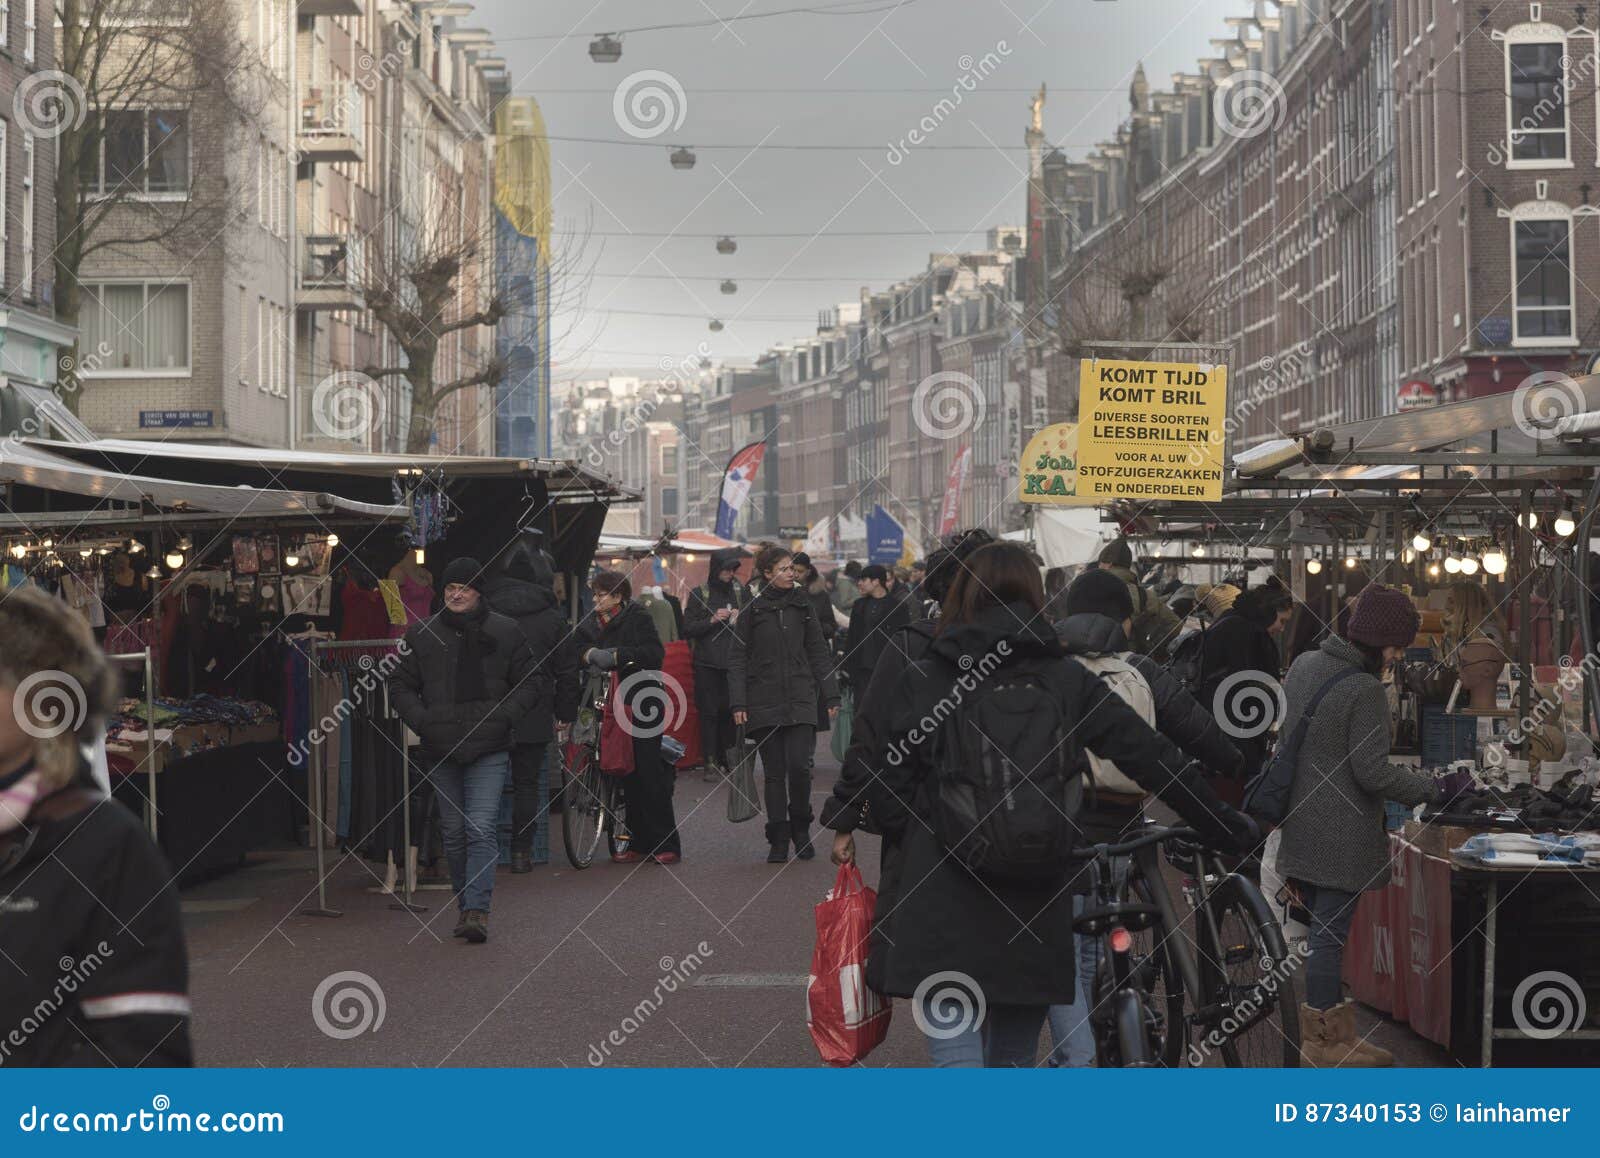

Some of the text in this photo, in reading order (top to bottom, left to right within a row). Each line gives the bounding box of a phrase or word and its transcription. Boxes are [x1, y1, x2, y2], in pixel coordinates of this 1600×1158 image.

[1100, 367, 1208, 386] KOMT TIJD
[1099, 387, 1207, 405] KOMT BRIL
[1094, 411, 1209, 425] DIVERSE SOORTEN
[1093, 426, 1209, 442] LEESBRILLEN
[1035, 454, 1077, 471] Joh
[1115, 452, 1187, 463] VOOR AL UW
[1080, 466, 1221, 480] STOFZUIGERZAKKEN
[1023, 473, 1077, 496] KA
[1094, 483, 1205, 496] EN ONDERDELEN
